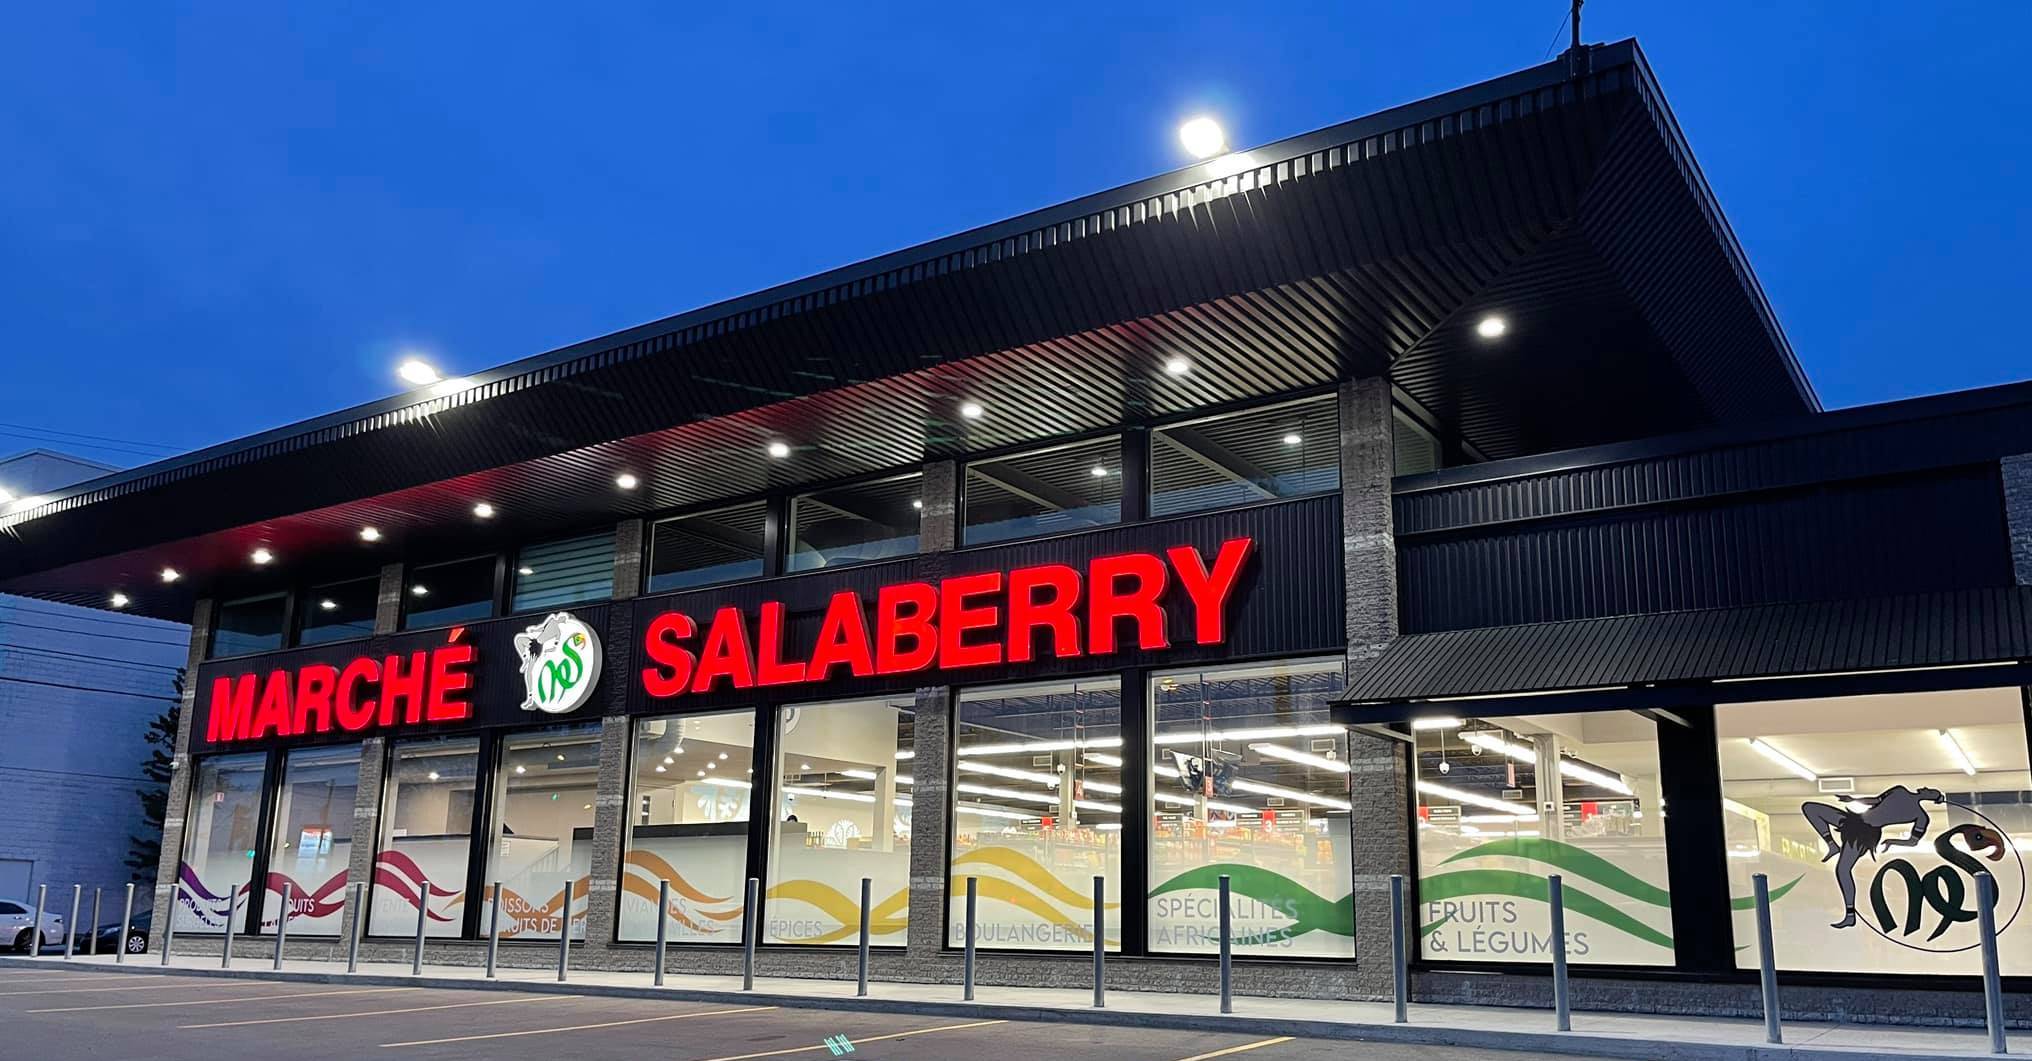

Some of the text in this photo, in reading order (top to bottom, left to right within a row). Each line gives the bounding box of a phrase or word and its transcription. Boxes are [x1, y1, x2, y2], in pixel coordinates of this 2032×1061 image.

[642, 537, 1255, 698] SALABERRY
[206, 628, 475, 743] MARCHÉ
[1264, 819, 1273, 833] 3
[626, 895, 687, 915] VIANES
[1156, 892, 1299, 921] SPÉCILITÉS
[1428, 900, 1518, 924] FRUITS
[541, 917, 558, 934] DE
[769, 916, 823, 938] ÉPICES
[955, 922, 1093, 944] BOULANGERIE
[1429, 925, 1590, 956] & LÉGUMES
